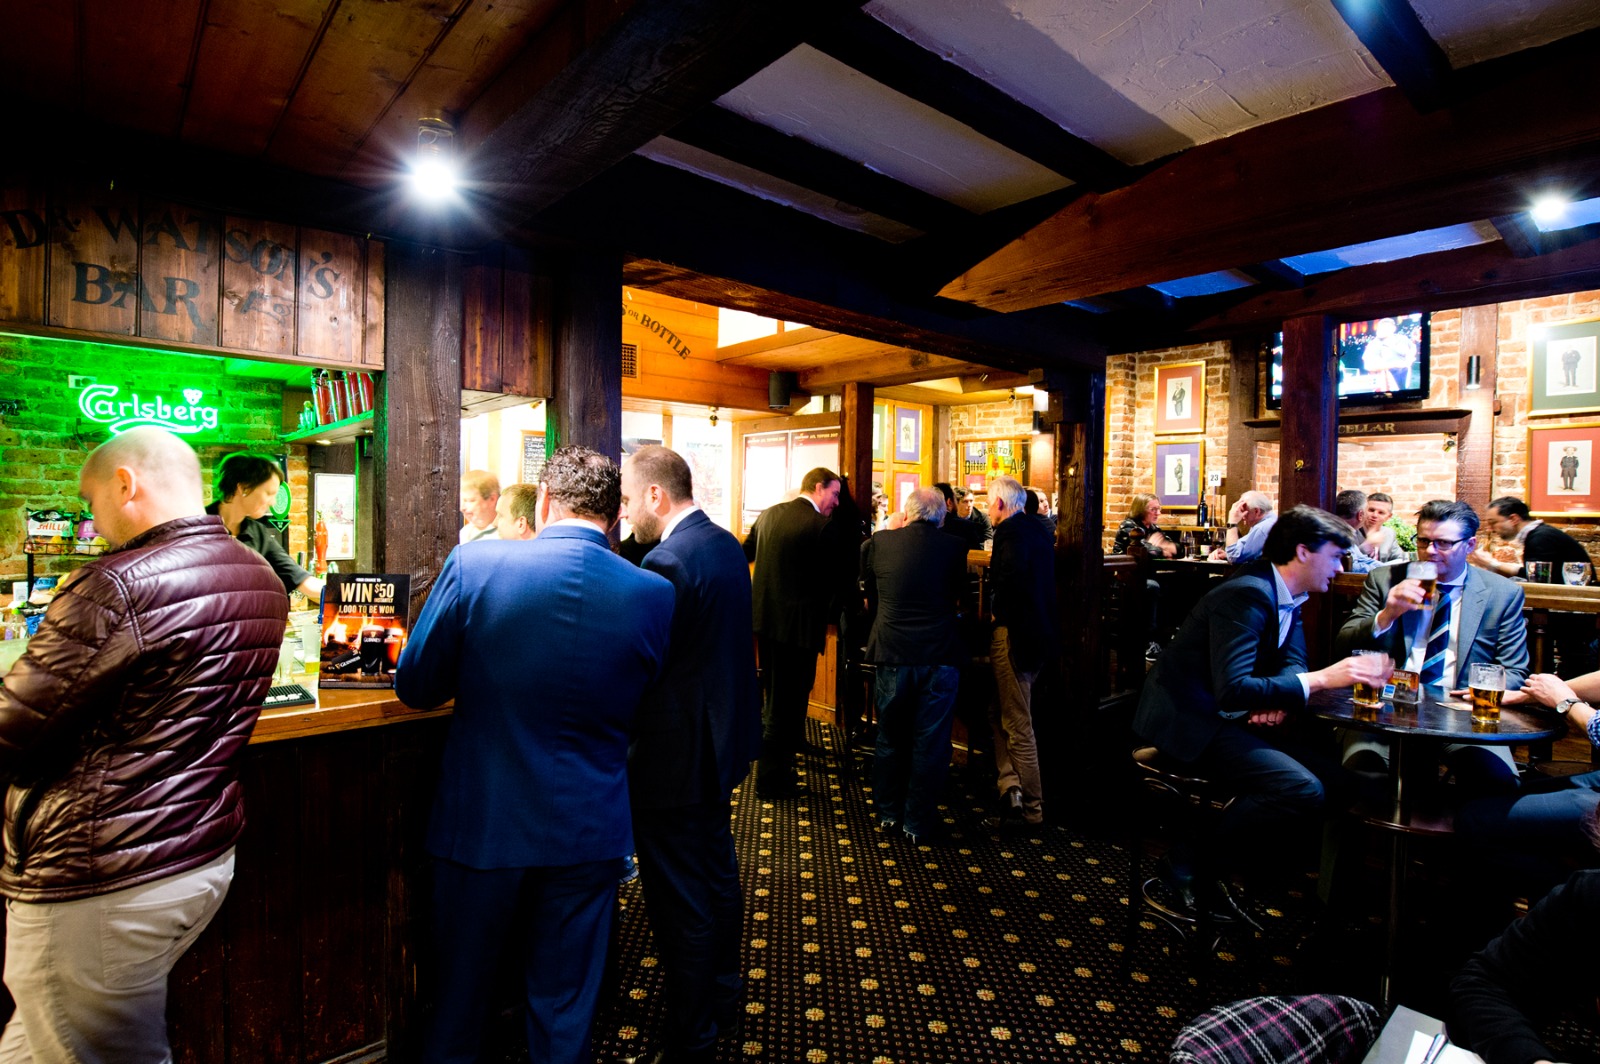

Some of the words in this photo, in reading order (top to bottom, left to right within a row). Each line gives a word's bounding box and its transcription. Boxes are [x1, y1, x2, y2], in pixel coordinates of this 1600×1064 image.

[94, 206, 342, 300] WATSON'S
[71, 260, 207, 329] BAR
[640, 313, 691, 360] BOTTLE
[79, 384, 218, 429] Carlsberg
[1338, 422, 1396, 434] CELLAR
[977, 447, 1014, 458] CARLTON
[1009, 458, 1026, 474] Ale
[341, 583, 373, 603] WIN
[374, 583, 395, 598] $50
[358, 605, 367, 614] TO
[369, 605, 378, 614] BE
[379, 605, 395, 614] WON
